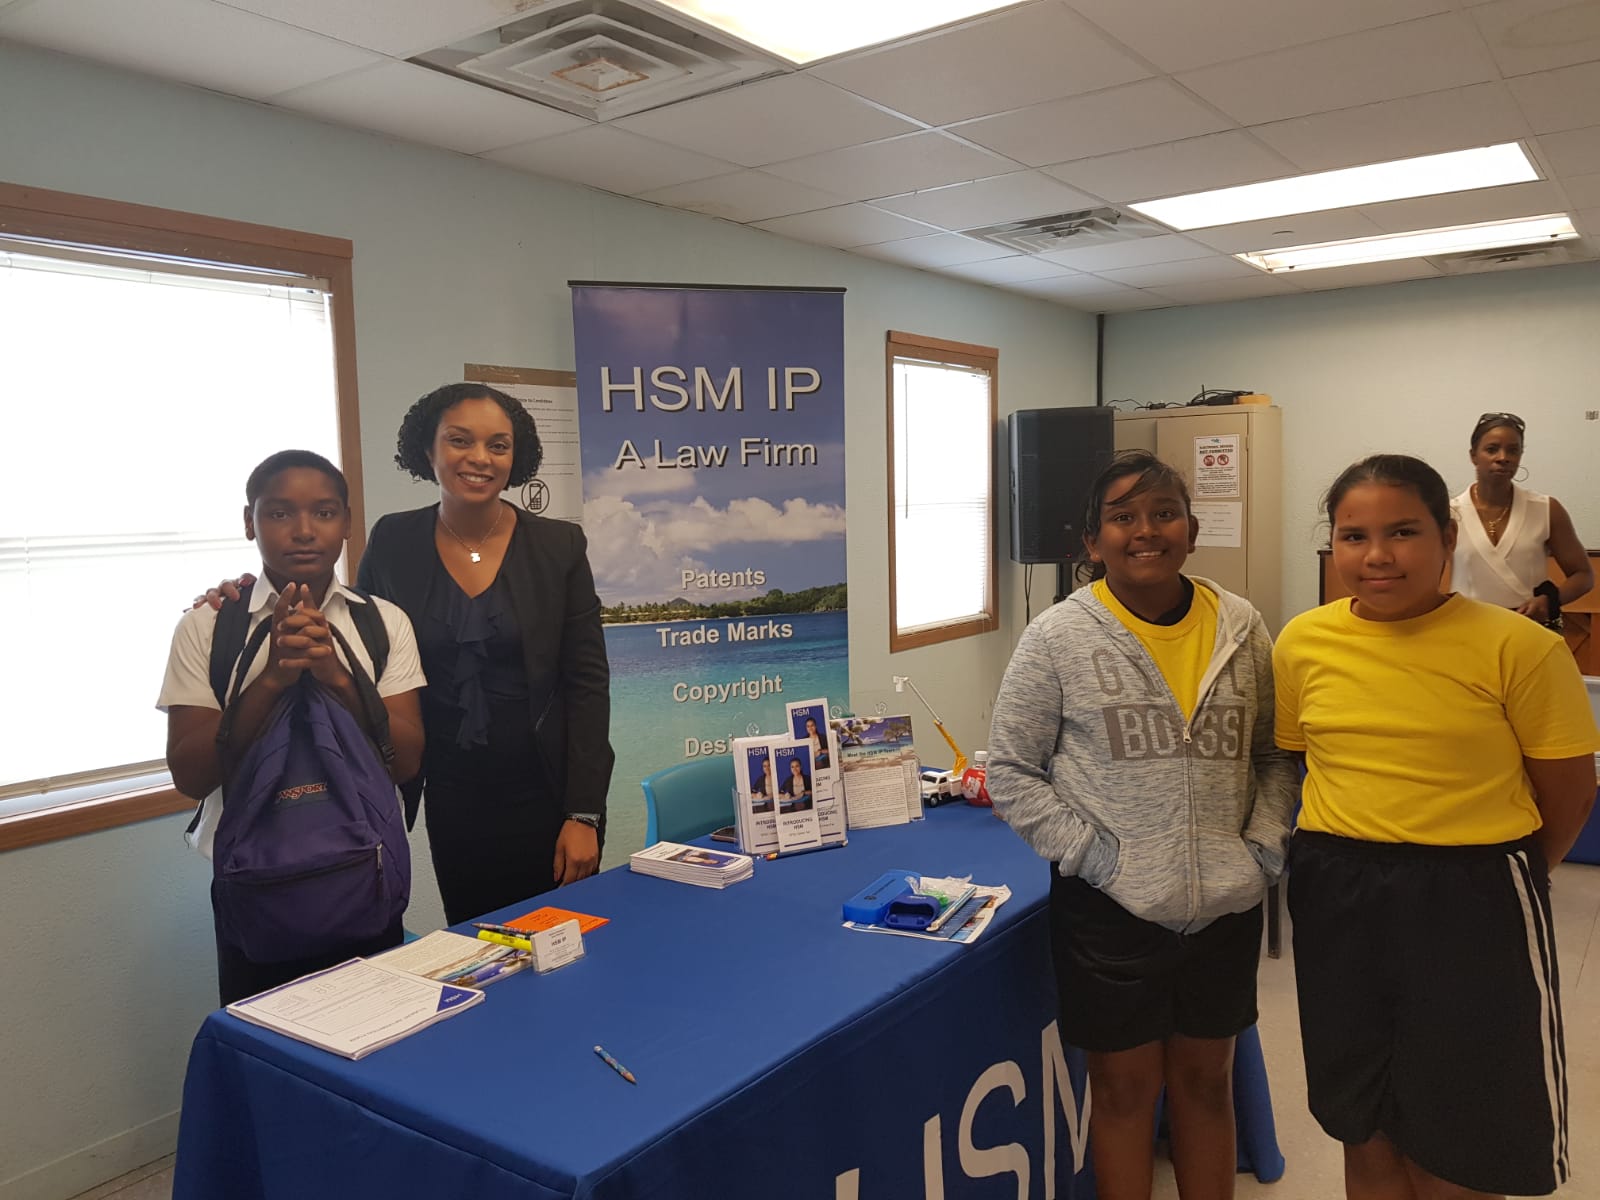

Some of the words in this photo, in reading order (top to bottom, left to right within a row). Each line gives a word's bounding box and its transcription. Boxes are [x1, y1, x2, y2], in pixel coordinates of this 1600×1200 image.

[601, 366, 743, 411] HSM
[768, 367, 821, 410] IP
[615, 440, 644, 469] A
[654, 440, 727, 467] Law
[741, 438, 817, 466] Firm
[682, 568, 766, 589] Patents
[656, 625, 720, 648] Trade
[727, 620, 793, 642] Marks
[673, 675, 783, 704] Copyright
[793, 708, 810, 716] HSM
[1117, 708, 1240, 758] BOSS
[748, 748, 767, 756] HSM
[776, 749, 795, 757] HSM
